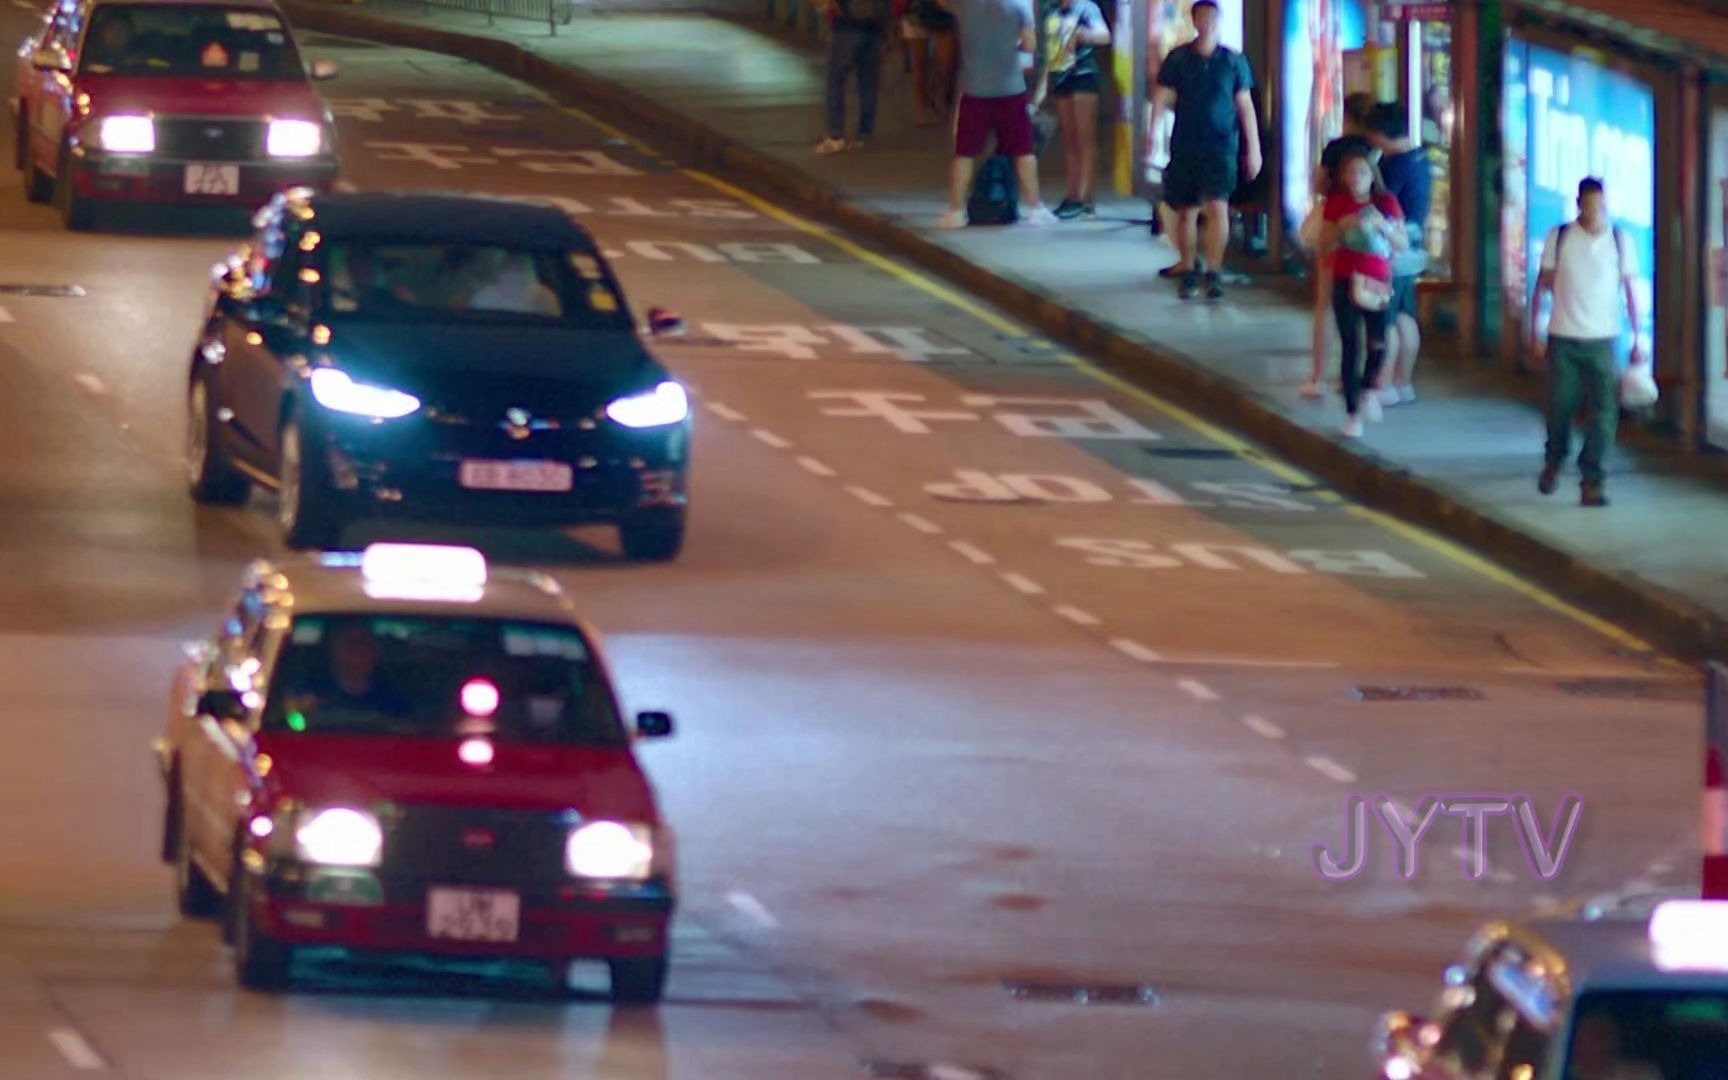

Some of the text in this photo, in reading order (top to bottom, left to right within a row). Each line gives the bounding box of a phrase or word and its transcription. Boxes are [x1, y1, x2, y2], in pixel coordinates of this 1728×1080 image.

[602, 240, 823, 264] BU
[924, 469, 1317, 512] STOP
[1056, 536, 1427, 578] BUS
